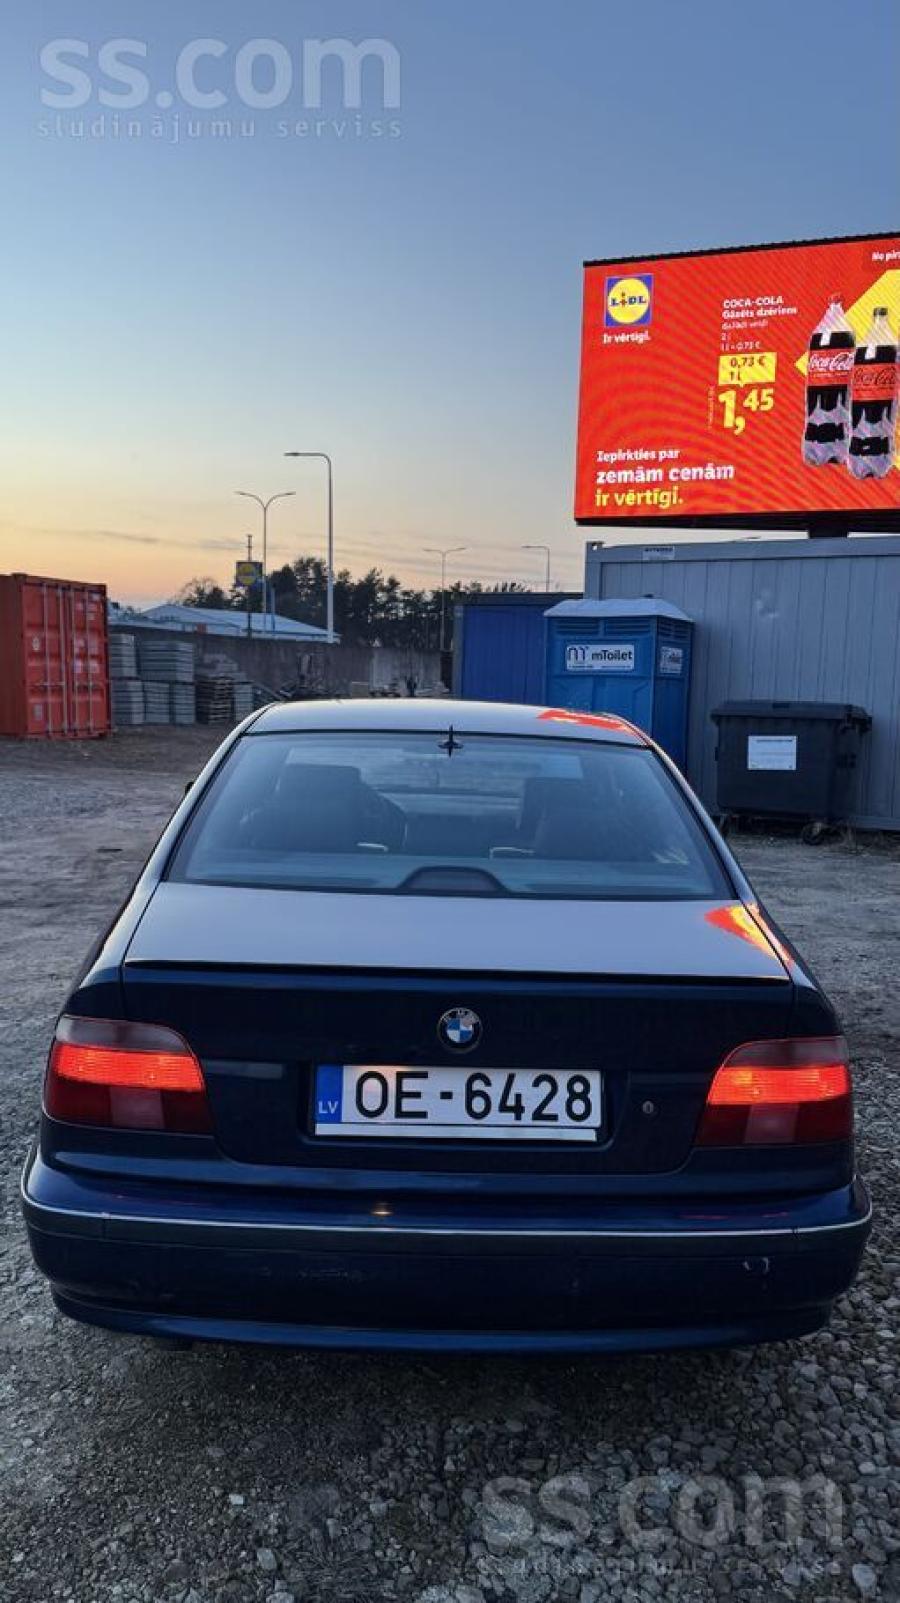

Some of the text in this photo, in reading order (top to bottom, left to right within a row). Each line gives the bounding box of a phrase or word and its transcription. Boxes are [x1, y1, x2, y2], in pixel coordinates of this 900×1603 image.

[723, 295, 784, 309] COCA-COLA
[730, 356, 755, 369] 0,73
[596, 448, 680, 464] Iepirkties par
[596, 462, 736, 484] zemām cenām
[595, 485, 684, 509] ir vērtīgi.
[591, 649, 633, 661] mToilet
[355, 1070, 593, 1123] OE-6428
[318, 1101, 339, 1114] LV
